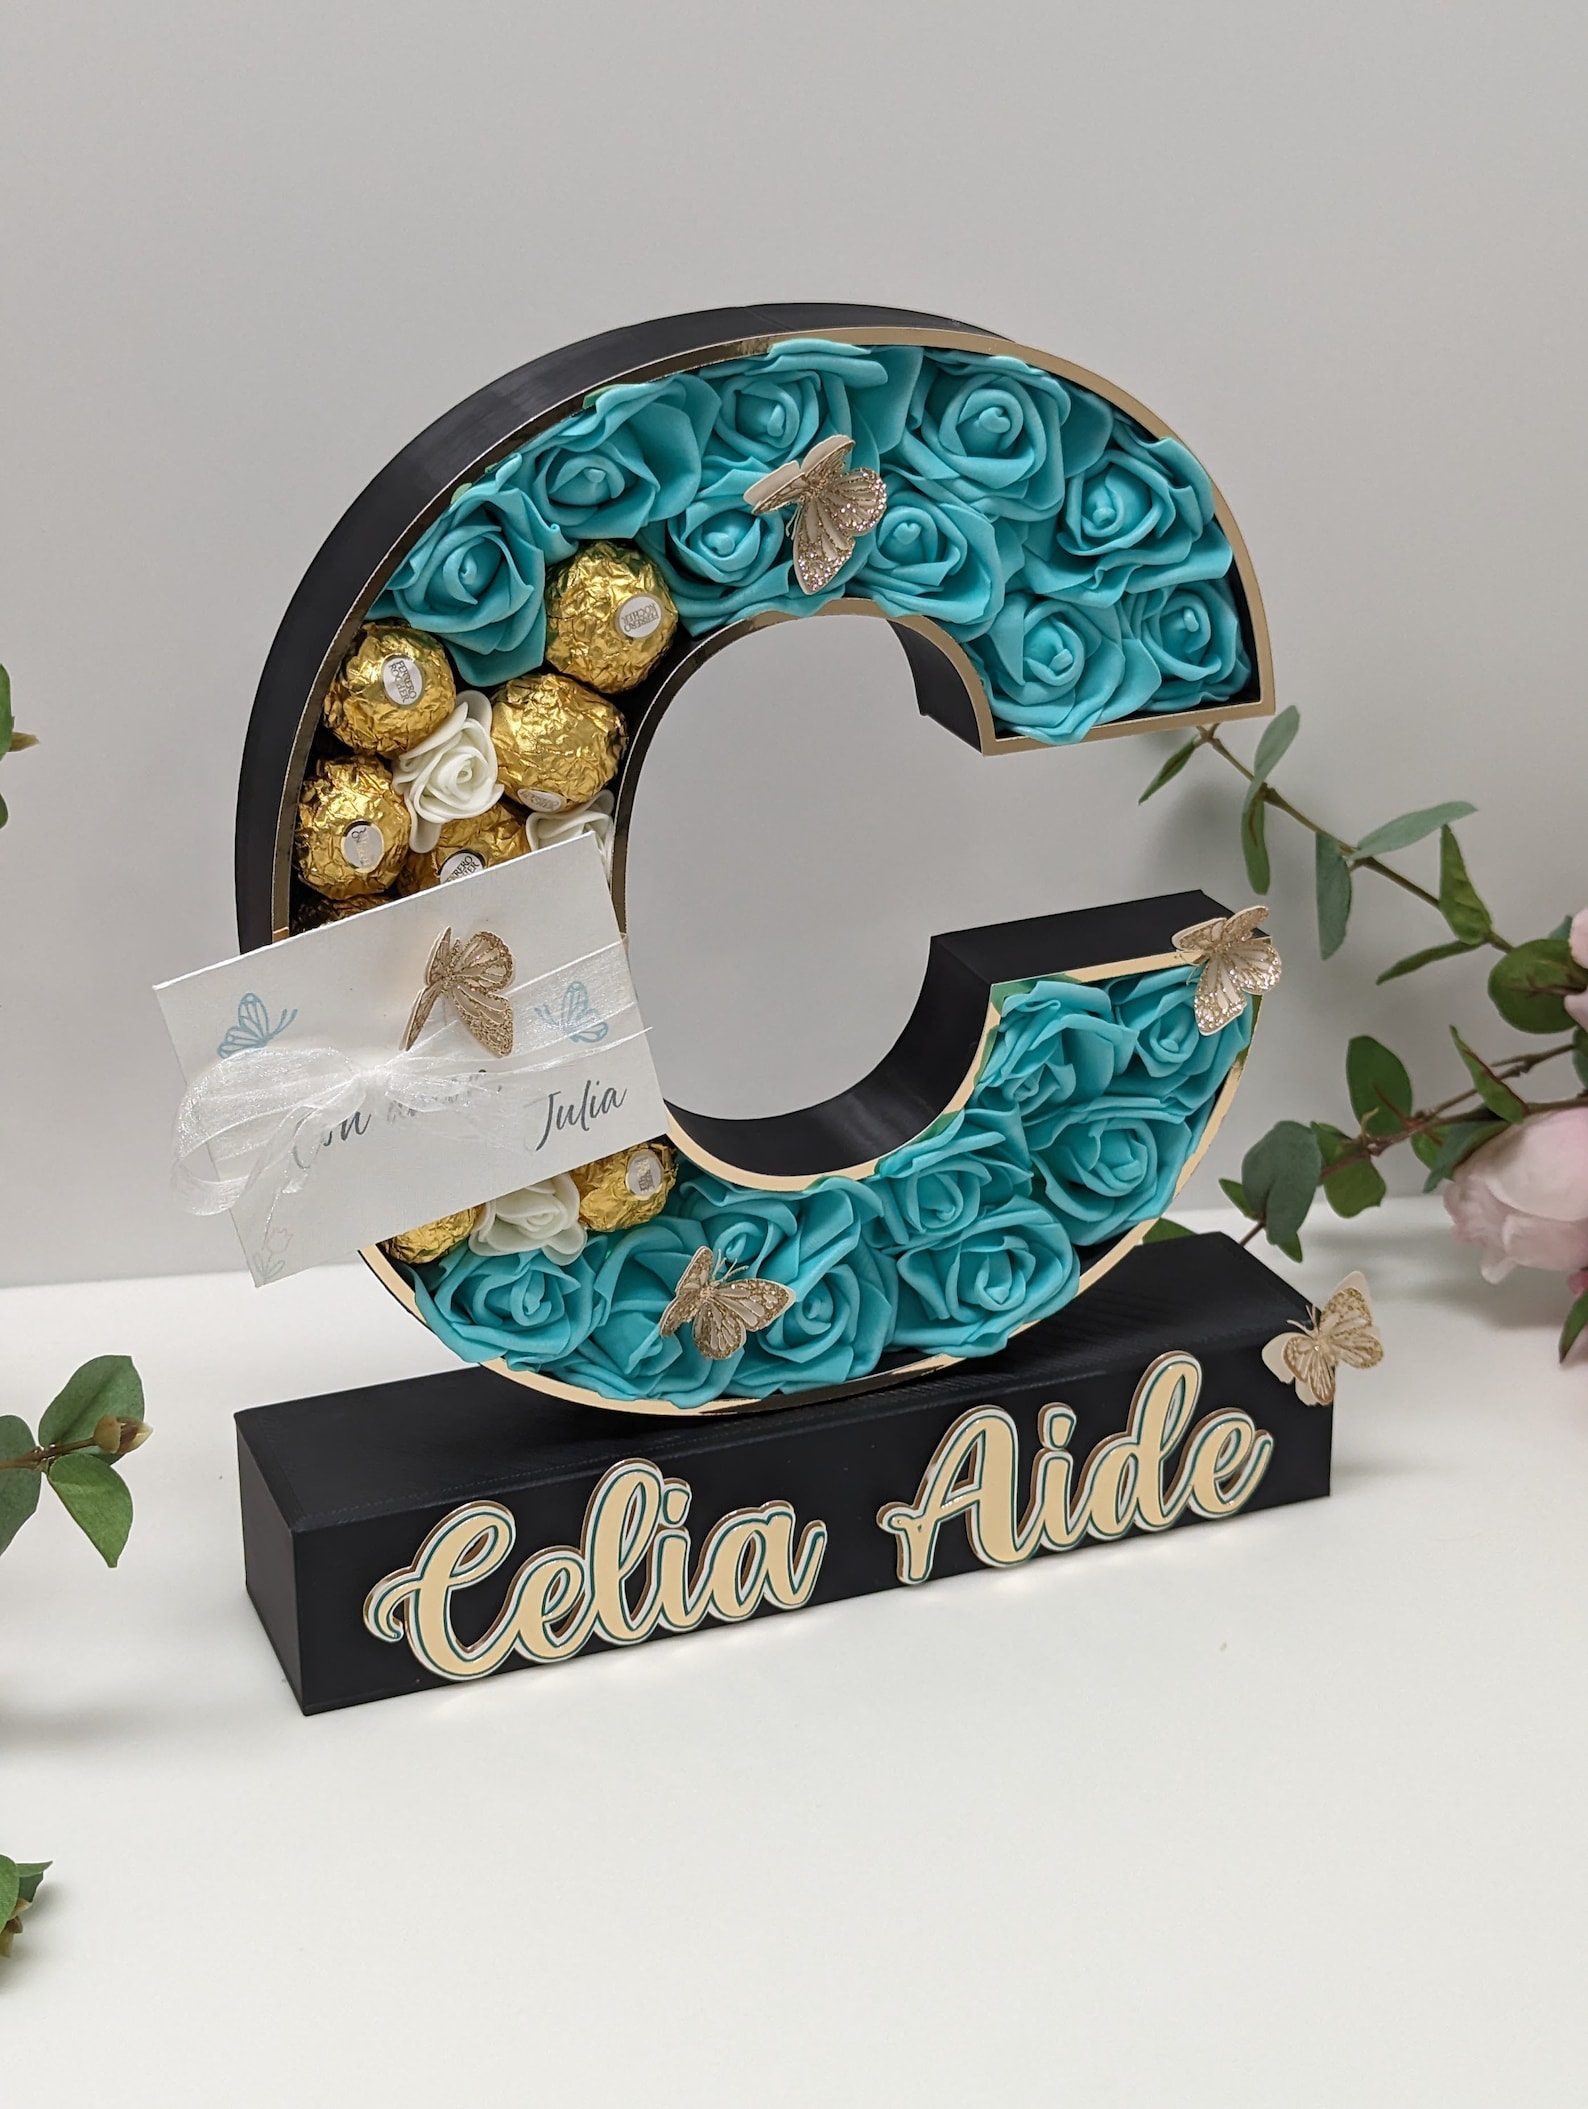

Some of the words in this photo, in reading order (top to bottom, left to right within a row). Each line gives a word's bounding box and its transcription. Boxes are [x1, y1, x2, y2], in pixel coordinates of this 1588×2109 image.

[398, 660, 417, 699] FERRERO
[536, 1079, 627, 1151] Julia
[363, 1457, 828, 1681] Celia
[876, 1349, 1274, 1585] Aide
